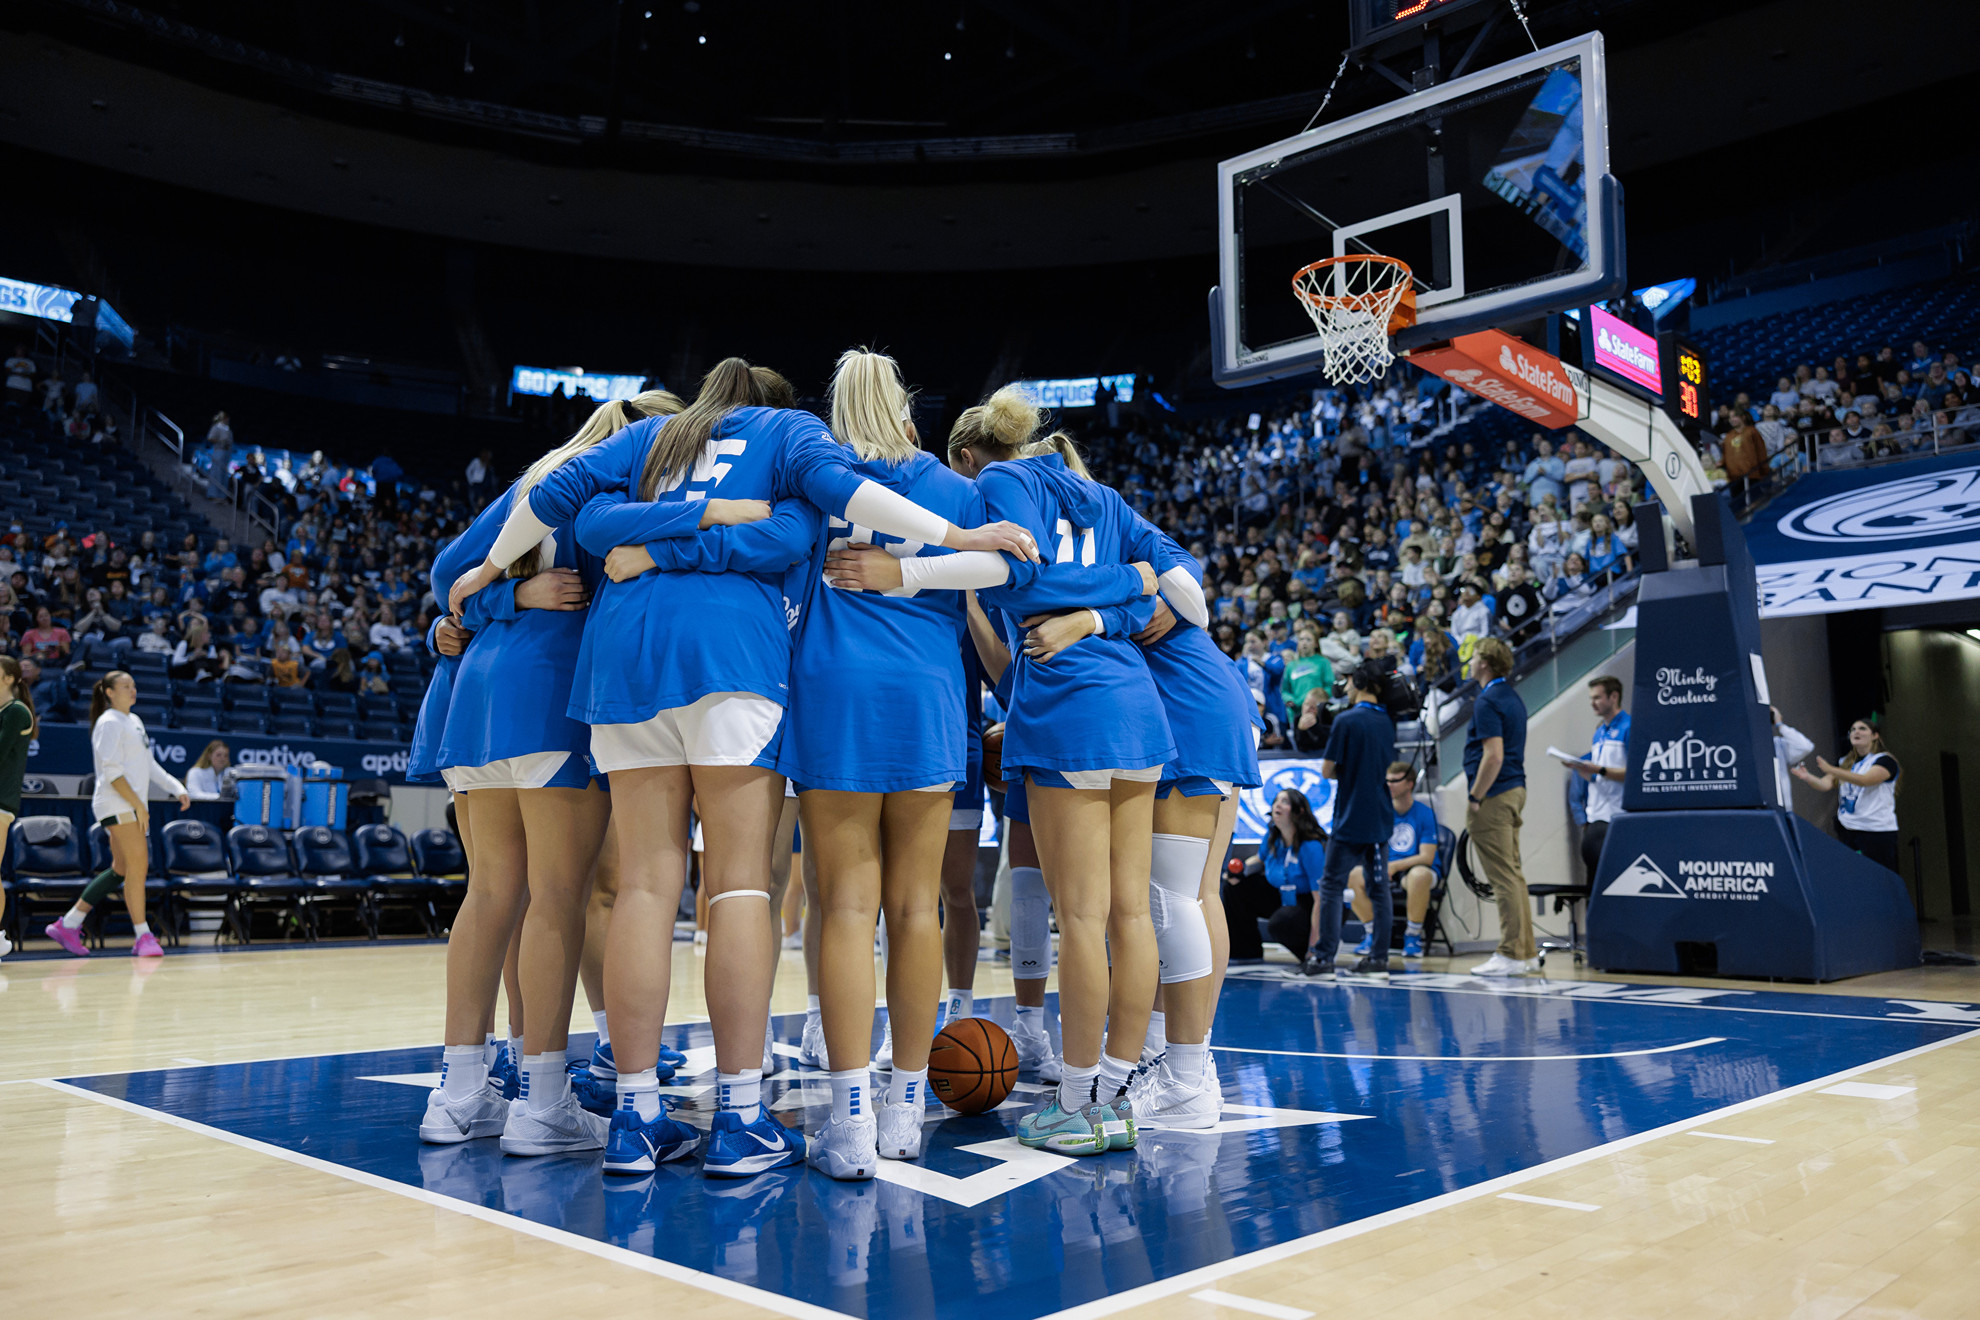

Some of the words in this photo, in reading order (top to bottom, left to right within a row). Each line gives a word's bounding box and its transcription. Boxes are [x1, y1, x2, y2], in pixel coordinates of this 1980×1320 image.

[1565, 368, 1590, 393] DING
[1056, 517, 1096, 567] 11
[1655, 667, 1718, 691] Minky
[1657, 686, 1718, 705] Couture
[150, 738, 187, 763] ive
[238, 745, 316, 767] aptive
[361, 751, 410, 776] apti
[1642, 766, 1737, 781] Capital
[1687, 783, 1737, 791] INVESTMENTS
[1679, 860, 1774, 877] MOUNTAIN
[1684, 876, 1768, 893] AMERICA
[1694, 892, 1727, 900] CREDIT
[1730, 893, 1759, 901] UNION
